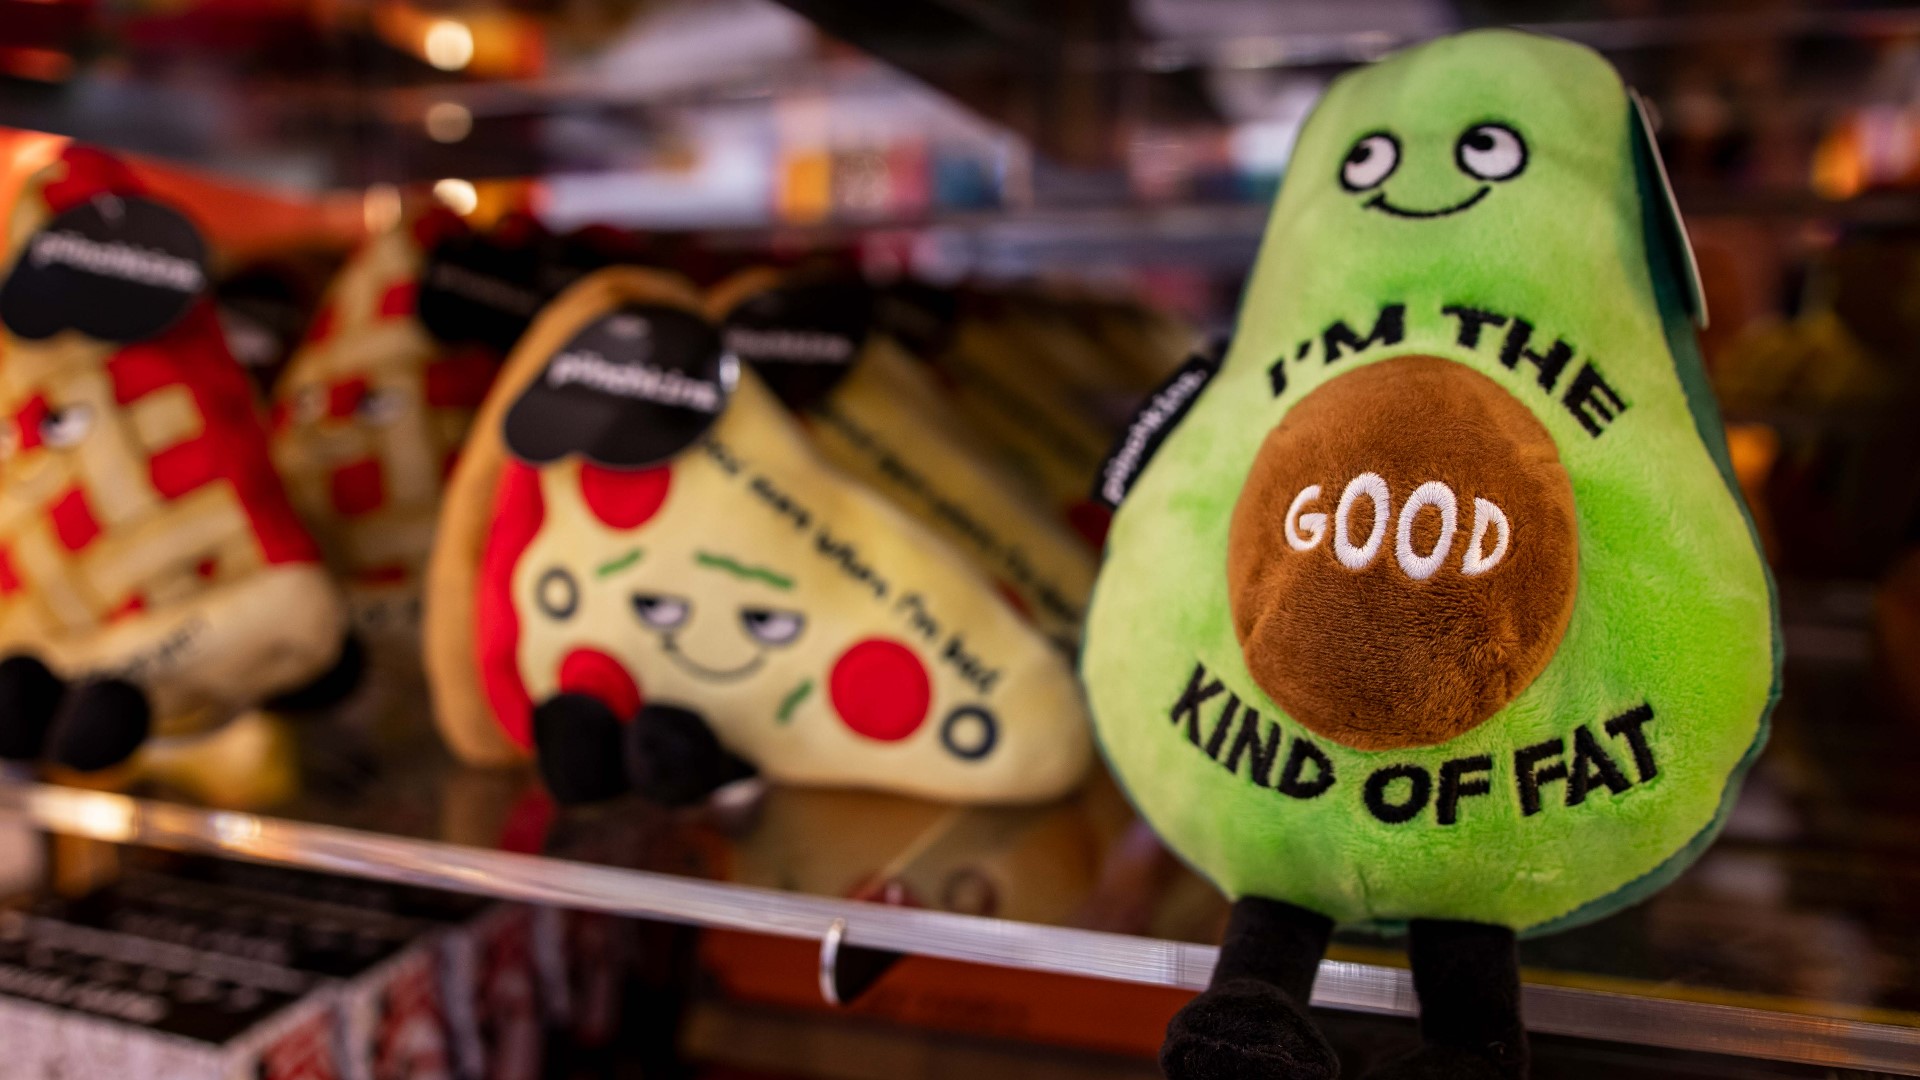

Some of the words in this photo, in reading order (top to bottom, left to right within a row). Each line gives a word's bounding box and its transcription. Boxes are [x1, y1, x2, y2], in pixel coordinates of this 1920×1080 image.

[1267, 304, 1406, 397] I'M
[1441, 304, 1633, 438] THE
[1283, 471, 1511, 581] GOOD
[1169, 662, 1337, 800] KIND
[1363, 754, 1494, 826] OF
[1514, 704, 1659, 817] FAT
